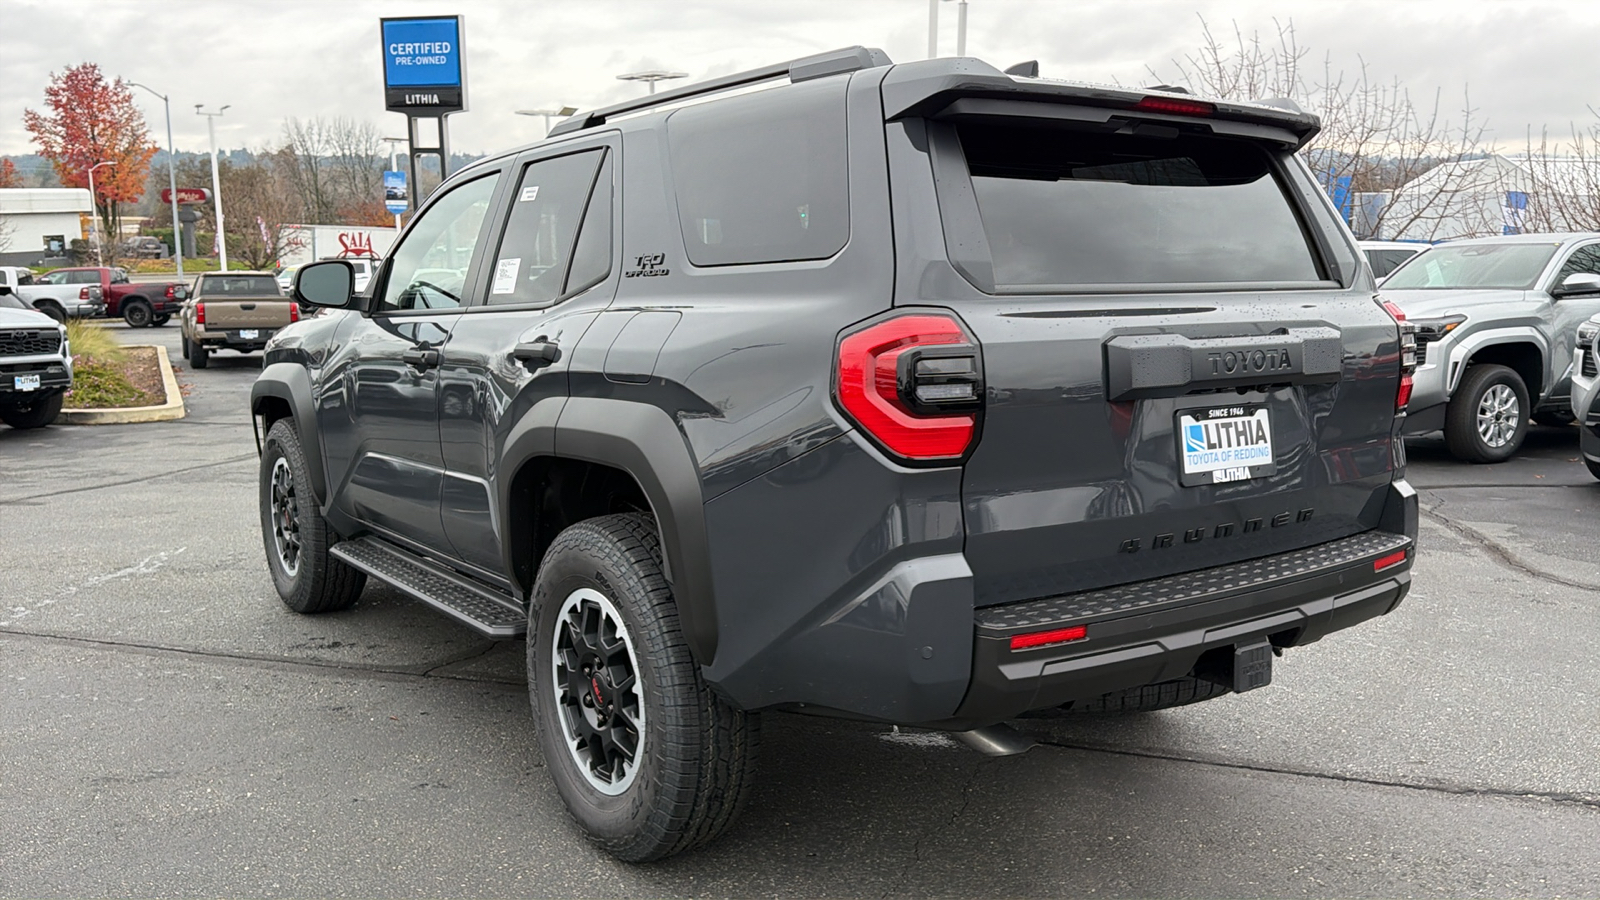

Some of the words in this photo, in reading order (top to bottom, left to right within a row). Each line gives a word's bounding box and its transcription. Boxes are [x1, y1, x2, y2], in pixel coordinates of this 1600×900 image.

[389, 41, 451, 55] CERTIFIED
[395, 55, 447, 66] PRE-OWNED
[405, 94, 440, 105] LITHIA
[337, 231, 376, 259] SAIA
[1208, 349, 1292, 374] TOYOTA
[1208, 408, 1229, 418] SINCE
[1229, 406, 1244, 416] 1946
[1204, 419, 1268, 450] LITHIA
[1187, 453, 1219, 465] TOYOTA
[1221, 451, 1232, 462] OF
[1235, 447, 1269, 459] REDDING
[1222, 467, 1251, 482] LITHIA
